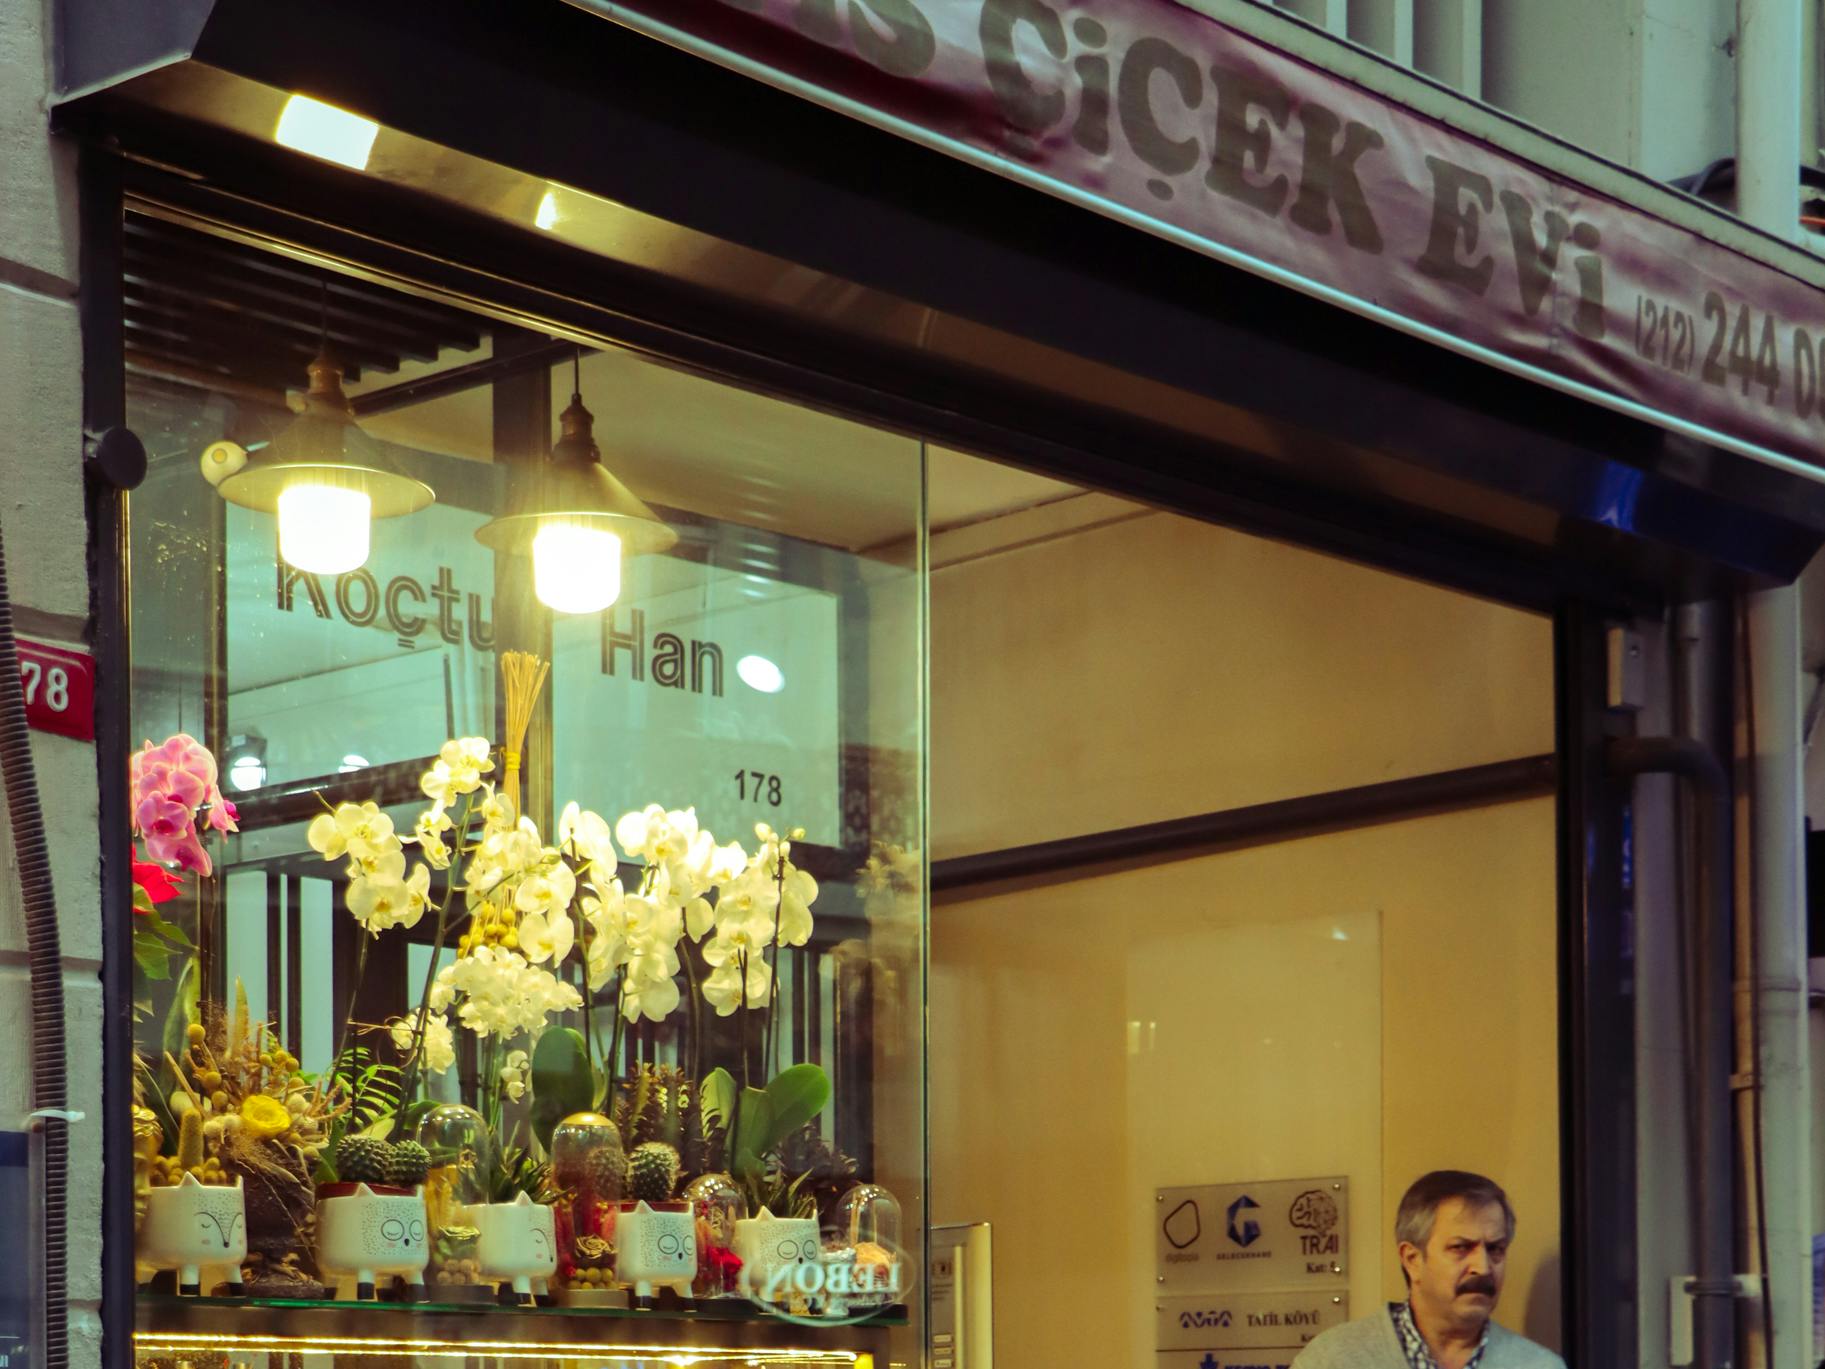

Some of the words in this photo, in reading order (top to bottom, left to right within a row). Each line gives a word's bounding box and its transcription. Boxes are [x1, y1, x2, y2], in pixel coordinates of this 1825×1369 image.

[1635, 295, 1695, 377] (212)
[1702, 290, 1781, 407] 244
[1793, 327, 1825, 423] 0
[276, 551, 496, 652] Koçtu
[601, 606, 725, 698] Han
[21, 661, 69, 713] 78
[734, 769, 783, 808] 178
